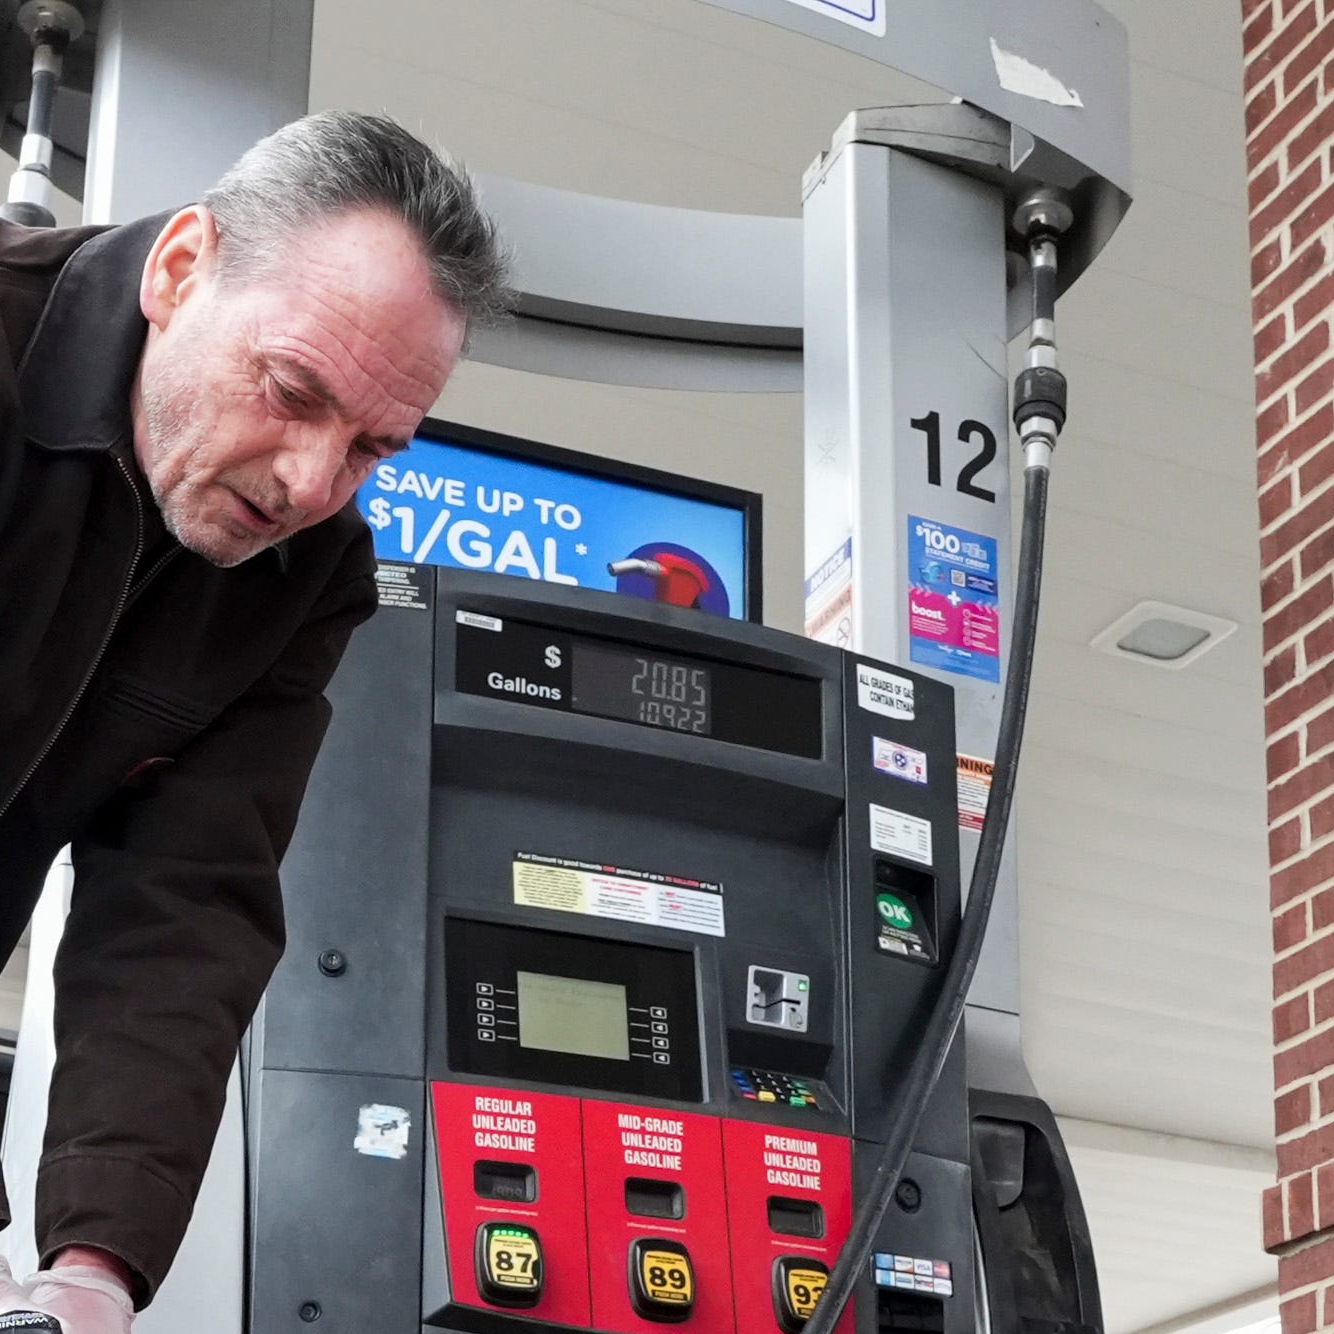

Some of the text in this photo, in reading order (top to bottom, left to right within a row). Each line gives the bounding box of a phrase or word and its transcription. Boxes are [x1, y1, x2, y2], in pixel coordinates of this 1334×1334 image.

[911, 411, 996, 503] 12
[375, 465, 582, 531] SAVE UP TO
[916, 525, 961, 554] $100
[544, 645, 562, 669] $
[487, 672, 562, 701] Gallons
[878, 901, 912, 923] OK
[475, 1096, 532, 1116] REGULAR
[472, 1114, 536, 1135] UNLEADED
[618, 1114, 684, 1136] MID-GRADE
[475, 1132, 535, 1152] GASOLINE
[621, 1132, 682, 1153] UNLEADED
[764, 1134, 817, 1155] PREMIUM
[624, 1150, 682, 1170] GASOLINE
[764, 1152, 821, 1173] UNLEADED
[767, 1169, 821, 1190] GASOLINE
[495, 1251, 532, 1274] 87
[649, 1266, 686, 1290] 89
